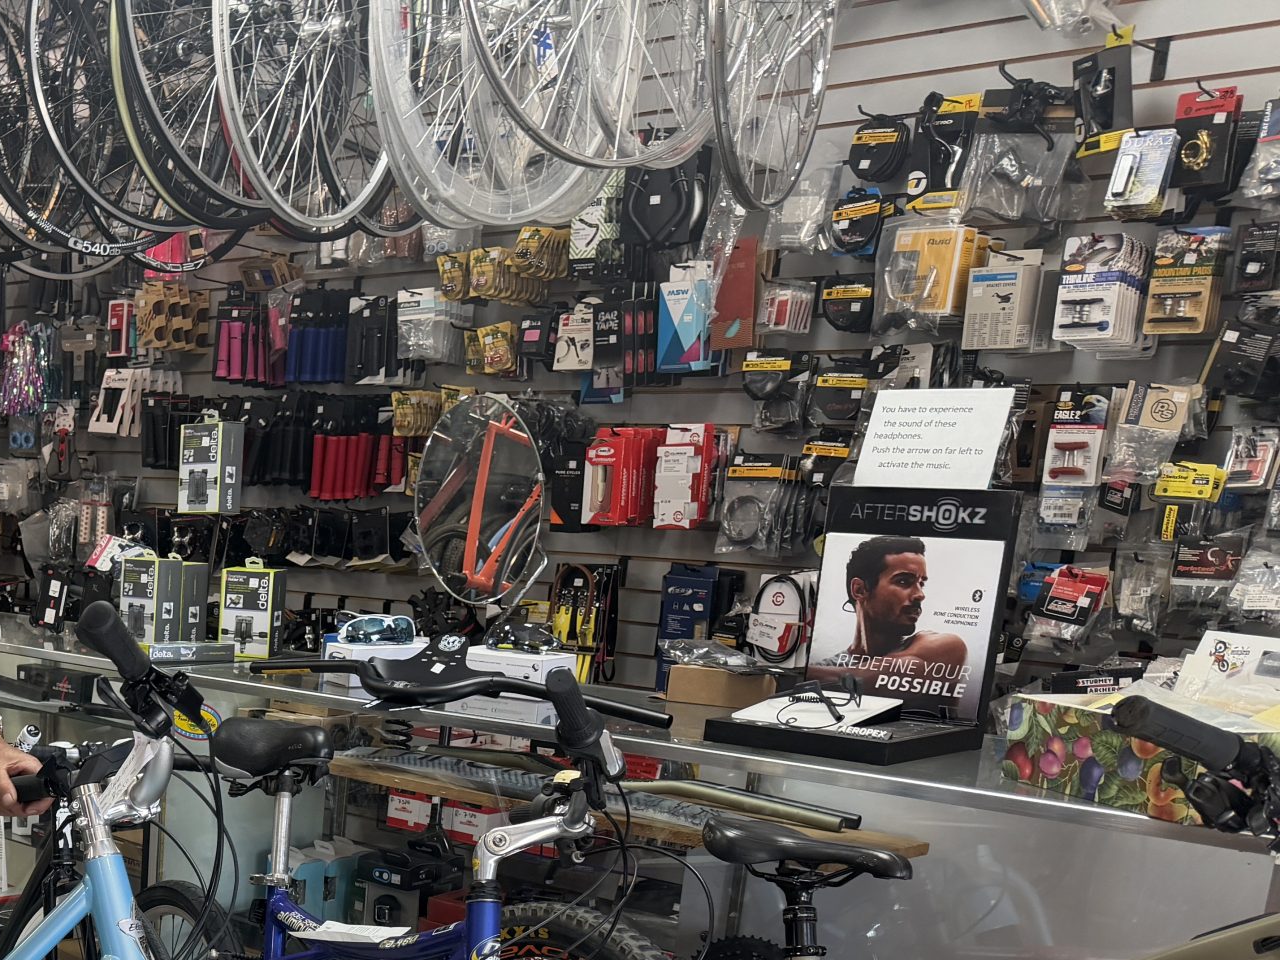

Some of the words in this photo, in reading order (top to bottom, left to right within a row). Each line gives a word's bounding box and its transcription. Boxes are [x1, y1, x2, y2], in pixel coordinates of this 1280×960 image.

[1153, 267, 1191, 278] MOUNTAIN
[1193, 266, 1212, 275] PADS
[667, 288, 689, 297] MSW
[596, 320, 620, 330] TAPE
[929, 407, 974, 415] experience
[883, 420, 897, 428] the
[898, 420, 923, 428] sound
[924, 420, 933, 428] of
[934, 420, 957, 428] these
[873, 432, 923, 441] headphones.
[871, 446, 890, 454] Push
[892, 446, 905, 454] the
[944, 447, 957, 455] far
[958, 447, 972, 456] left
[974, 448, 984, 456] to
[877, 461, 909, 469] activate
[925, 462, 951, 470] music.
[850, 502, 988, 525] AFTERSHOKZ
[257, 576, 269, 610] delta.
[947, 612, 980, 620] CONDUCTION
[944, 619, 978, 627] HEADPHONES
[152, 650, 174, 658] delta.
[836, 653, 920, 676] REDEFINE
[923, 661, 973, 681] YOUR
[875, 675, 968, 699] POSSIBLE
[838, 725, 889, 738] AEROPEX
